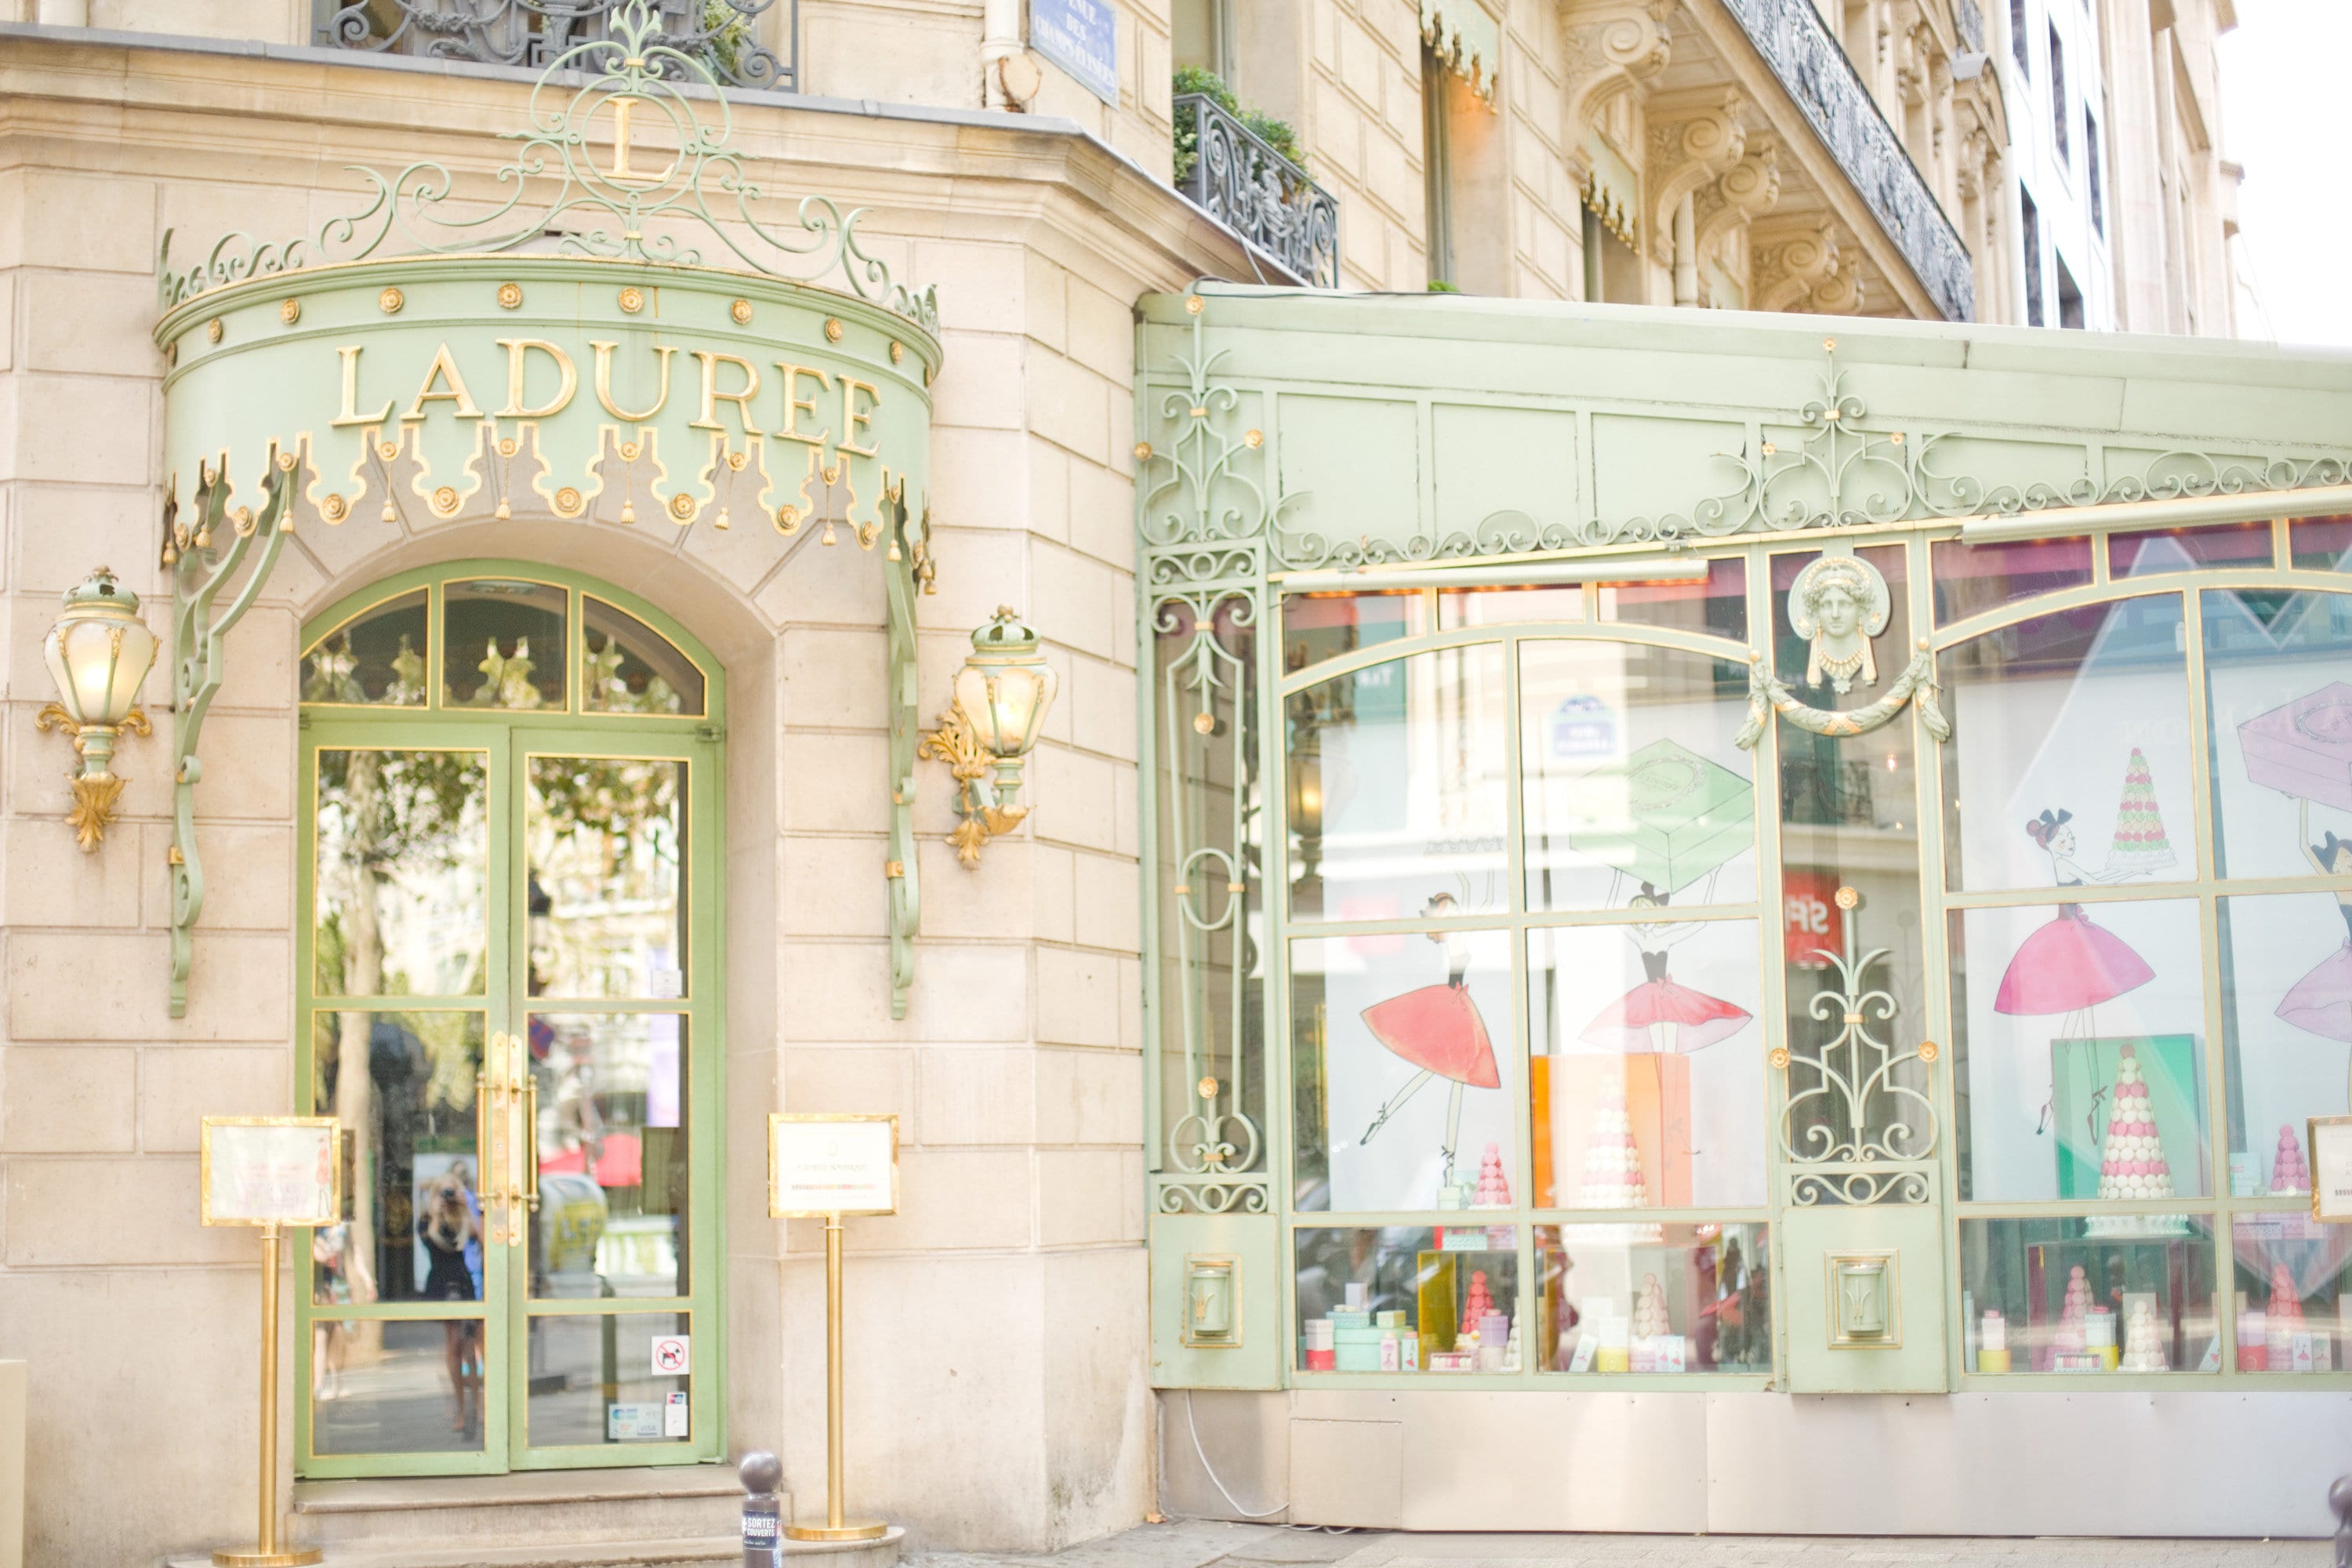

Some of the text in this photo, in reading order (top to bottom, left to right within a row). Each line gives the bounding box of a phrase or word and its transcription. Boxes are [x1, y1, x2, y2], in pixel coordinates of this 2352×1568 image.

[601, 97, 674, 182] L
[328, 337, 882, 458] LADUREE
[747, 1518, 775, 1529] SORTEZ
